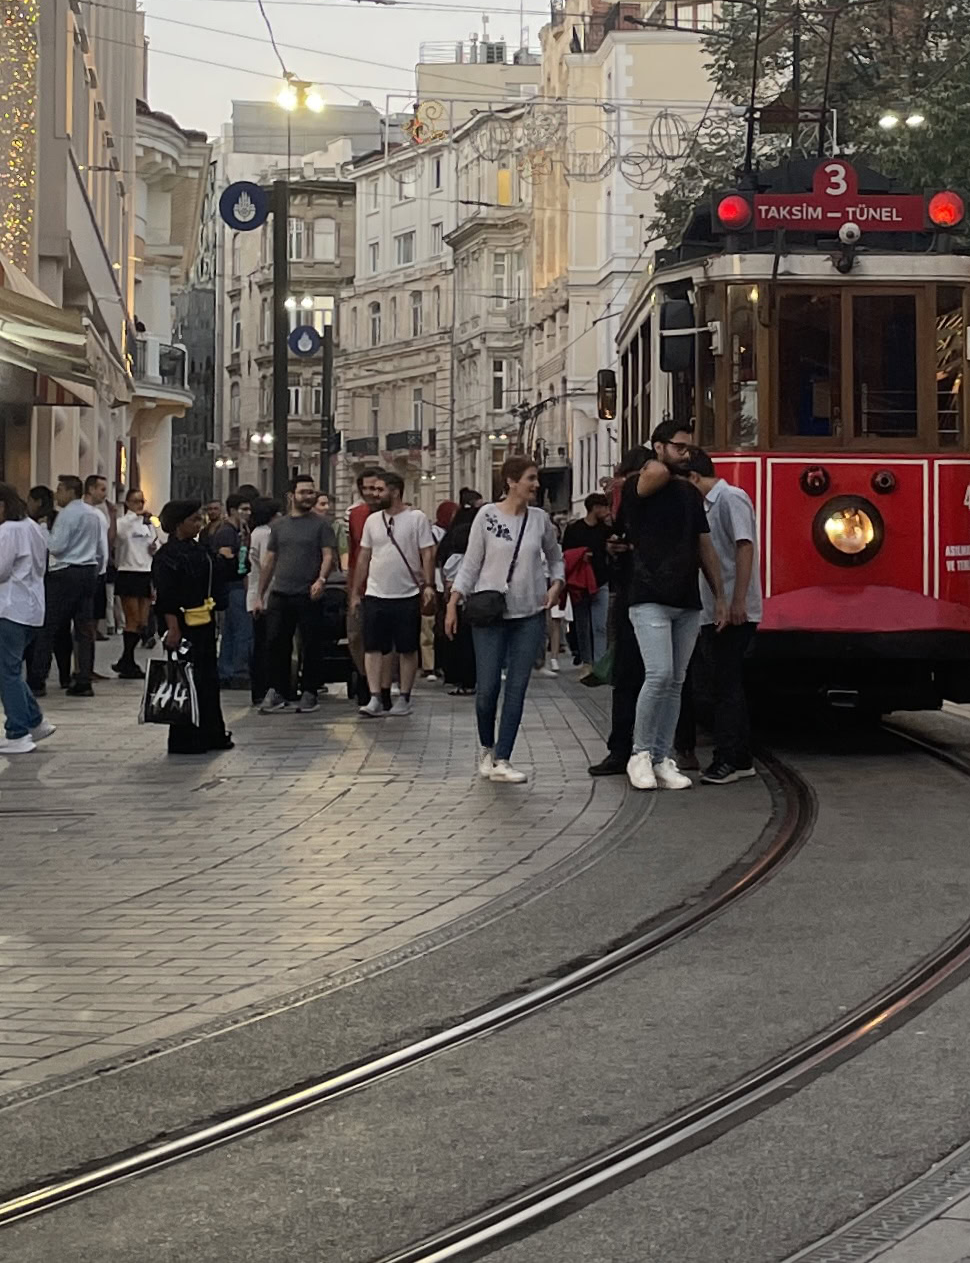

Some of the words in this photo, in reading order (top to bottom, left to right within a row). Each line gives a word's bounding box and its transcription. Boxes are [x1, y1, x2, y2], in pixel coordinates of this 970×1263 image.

[823, 163, 848, 196] 3
[758, 203, 822, 220] TAKSİM
[845, 204, 903, 221] TÜNEL
